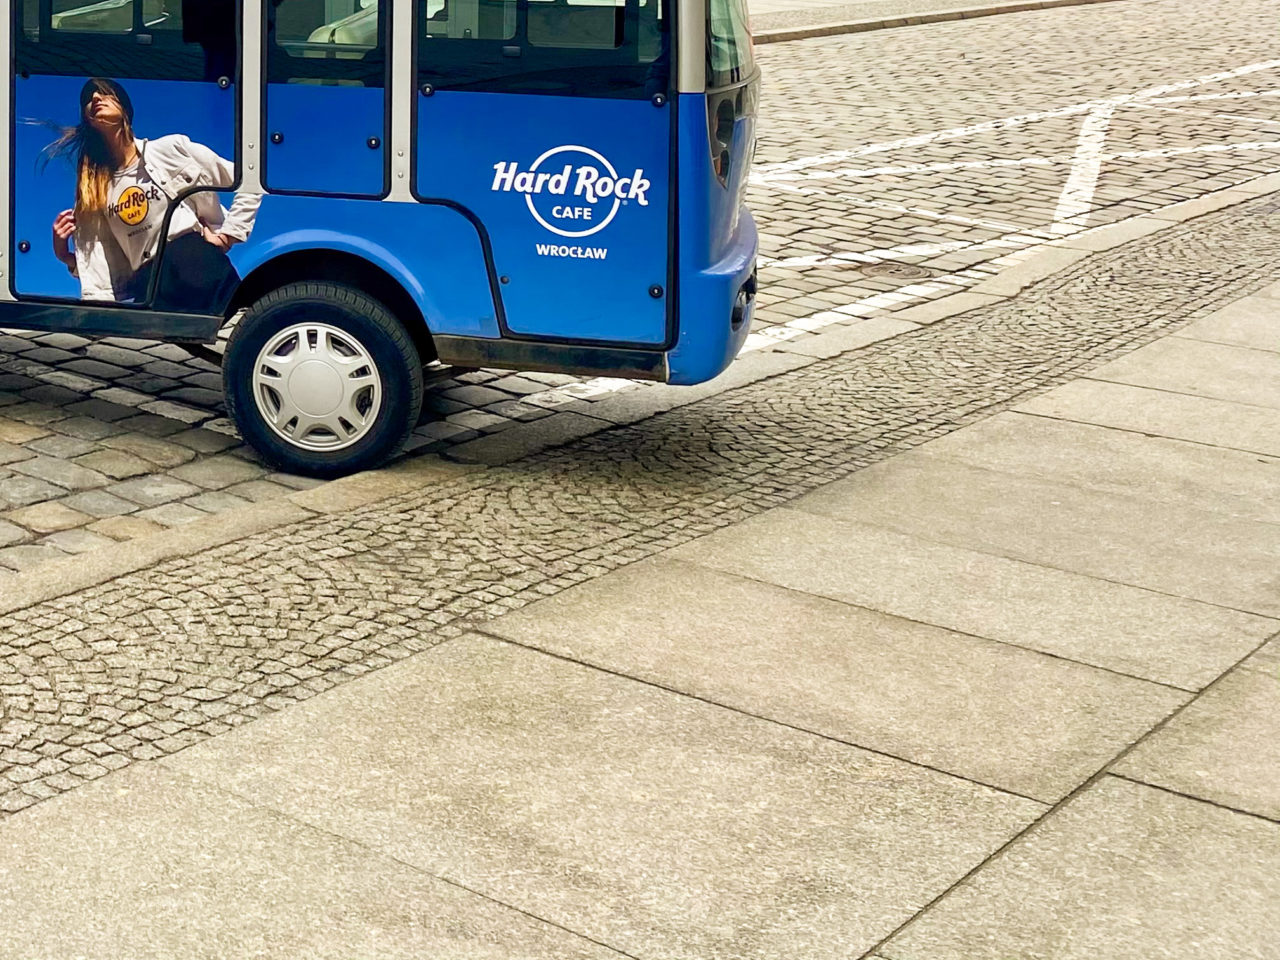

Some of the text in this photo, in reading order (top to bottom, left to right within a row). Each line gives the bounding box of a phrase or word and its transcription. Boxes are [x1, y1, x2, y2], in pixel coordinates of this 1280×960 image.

[491, 161, 651, 206] Hard Rock
[108, 186, 160, 217] Hard Rock
[551, 206, 592, 220] CAFE
[535, 243, 608, 260] WROCŁAW
